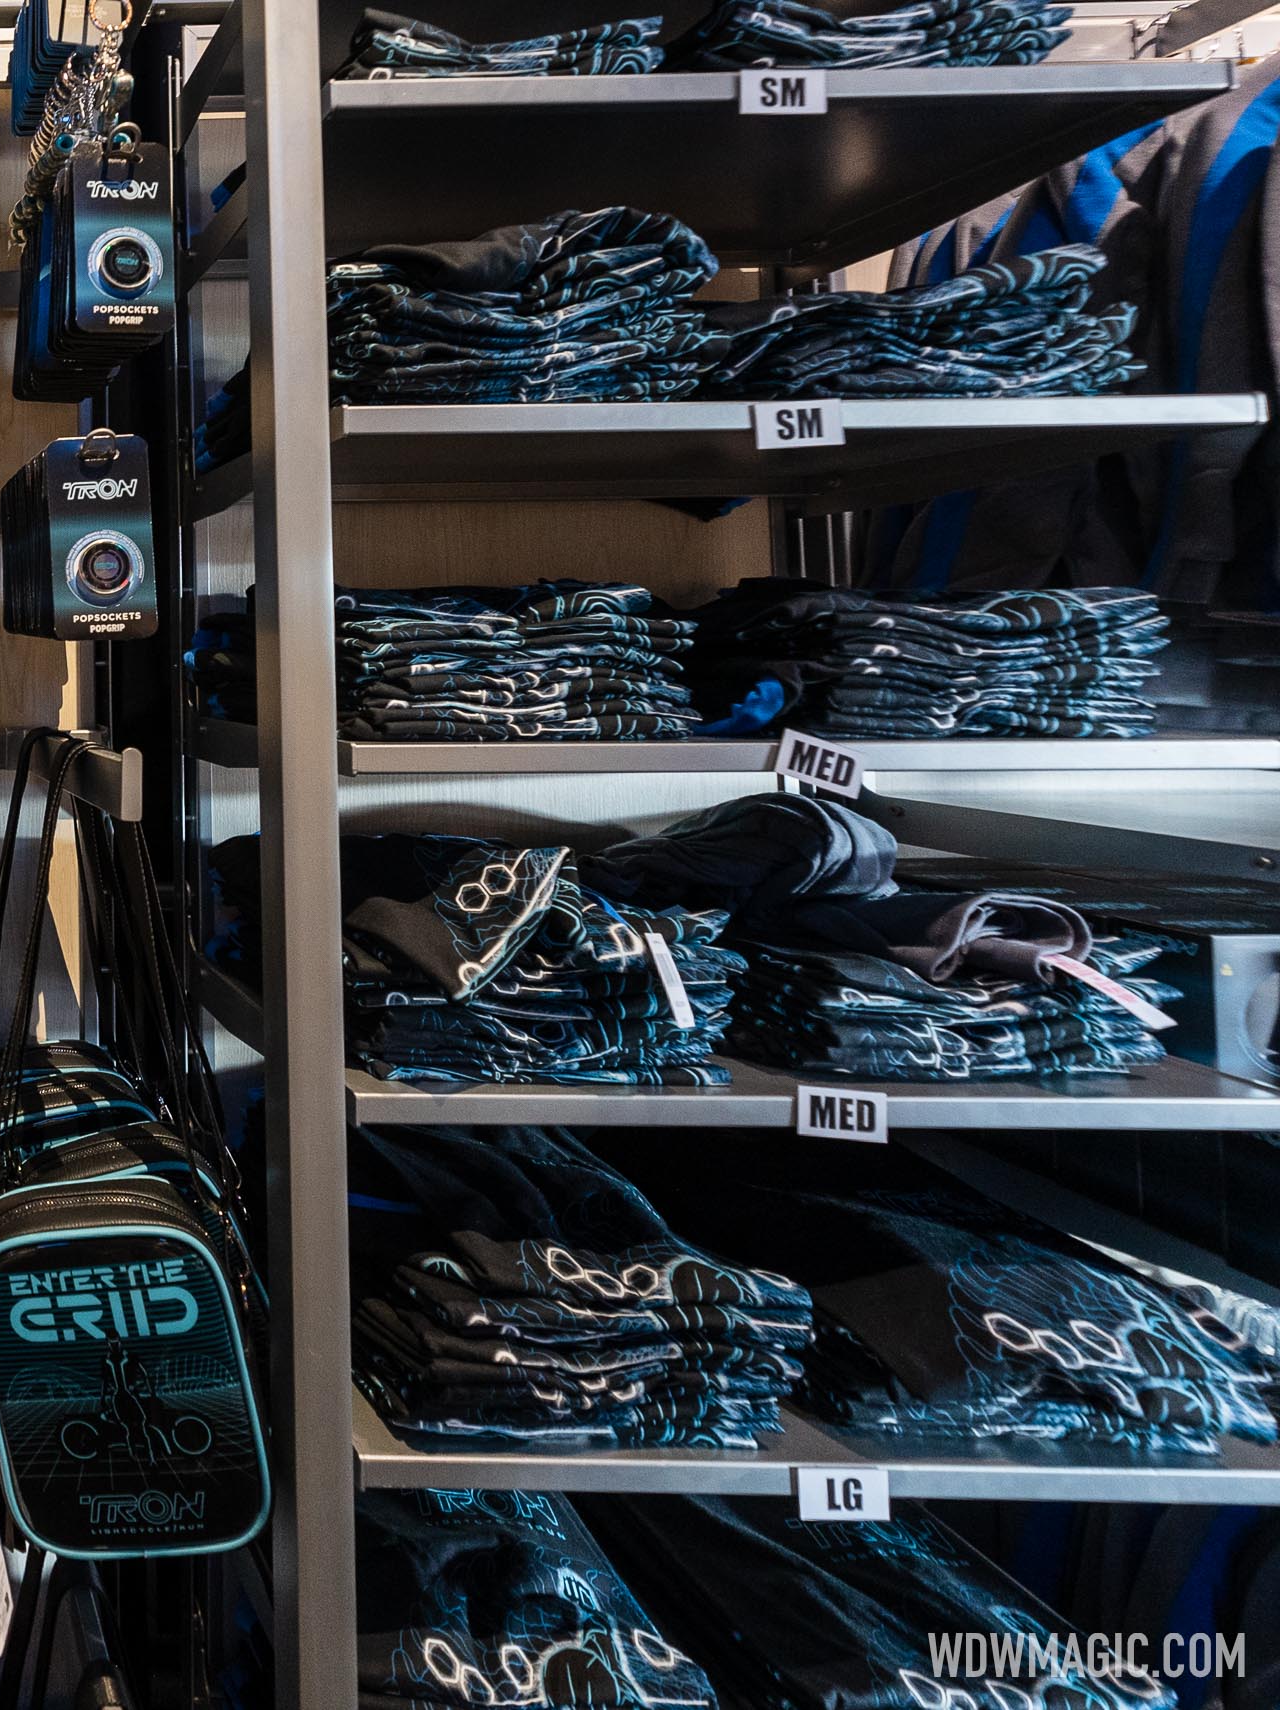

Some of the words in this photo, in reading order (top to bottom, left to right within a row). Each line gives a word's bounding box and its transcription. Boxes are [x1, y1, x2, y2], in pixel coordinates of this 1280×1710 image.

[760, 77, 806, 107] SM
[86, 179, 159, 200] TRON
[93, 305, 159, 314] POPSOCKETS
[109, 315, 143, 325] POPGRIP
[776, 407, 823, 440] SM
[62, 478, 138, 500] TRON
[73, 611, 142, 623] POPSOCKETS
[90, 623, 125, 633] POPGRIP
[788, 739, 855, 787] MED
[809, 1095, 876, 1133] MED
[8, 1267, 117, 1296] ENTER
[120, 1259, 189, 1287] THE
[9, 1286, 199, 1342] GRID
[80, 1490, 205, 1524] TRON
[826, 1478, 864, 1511] LG
